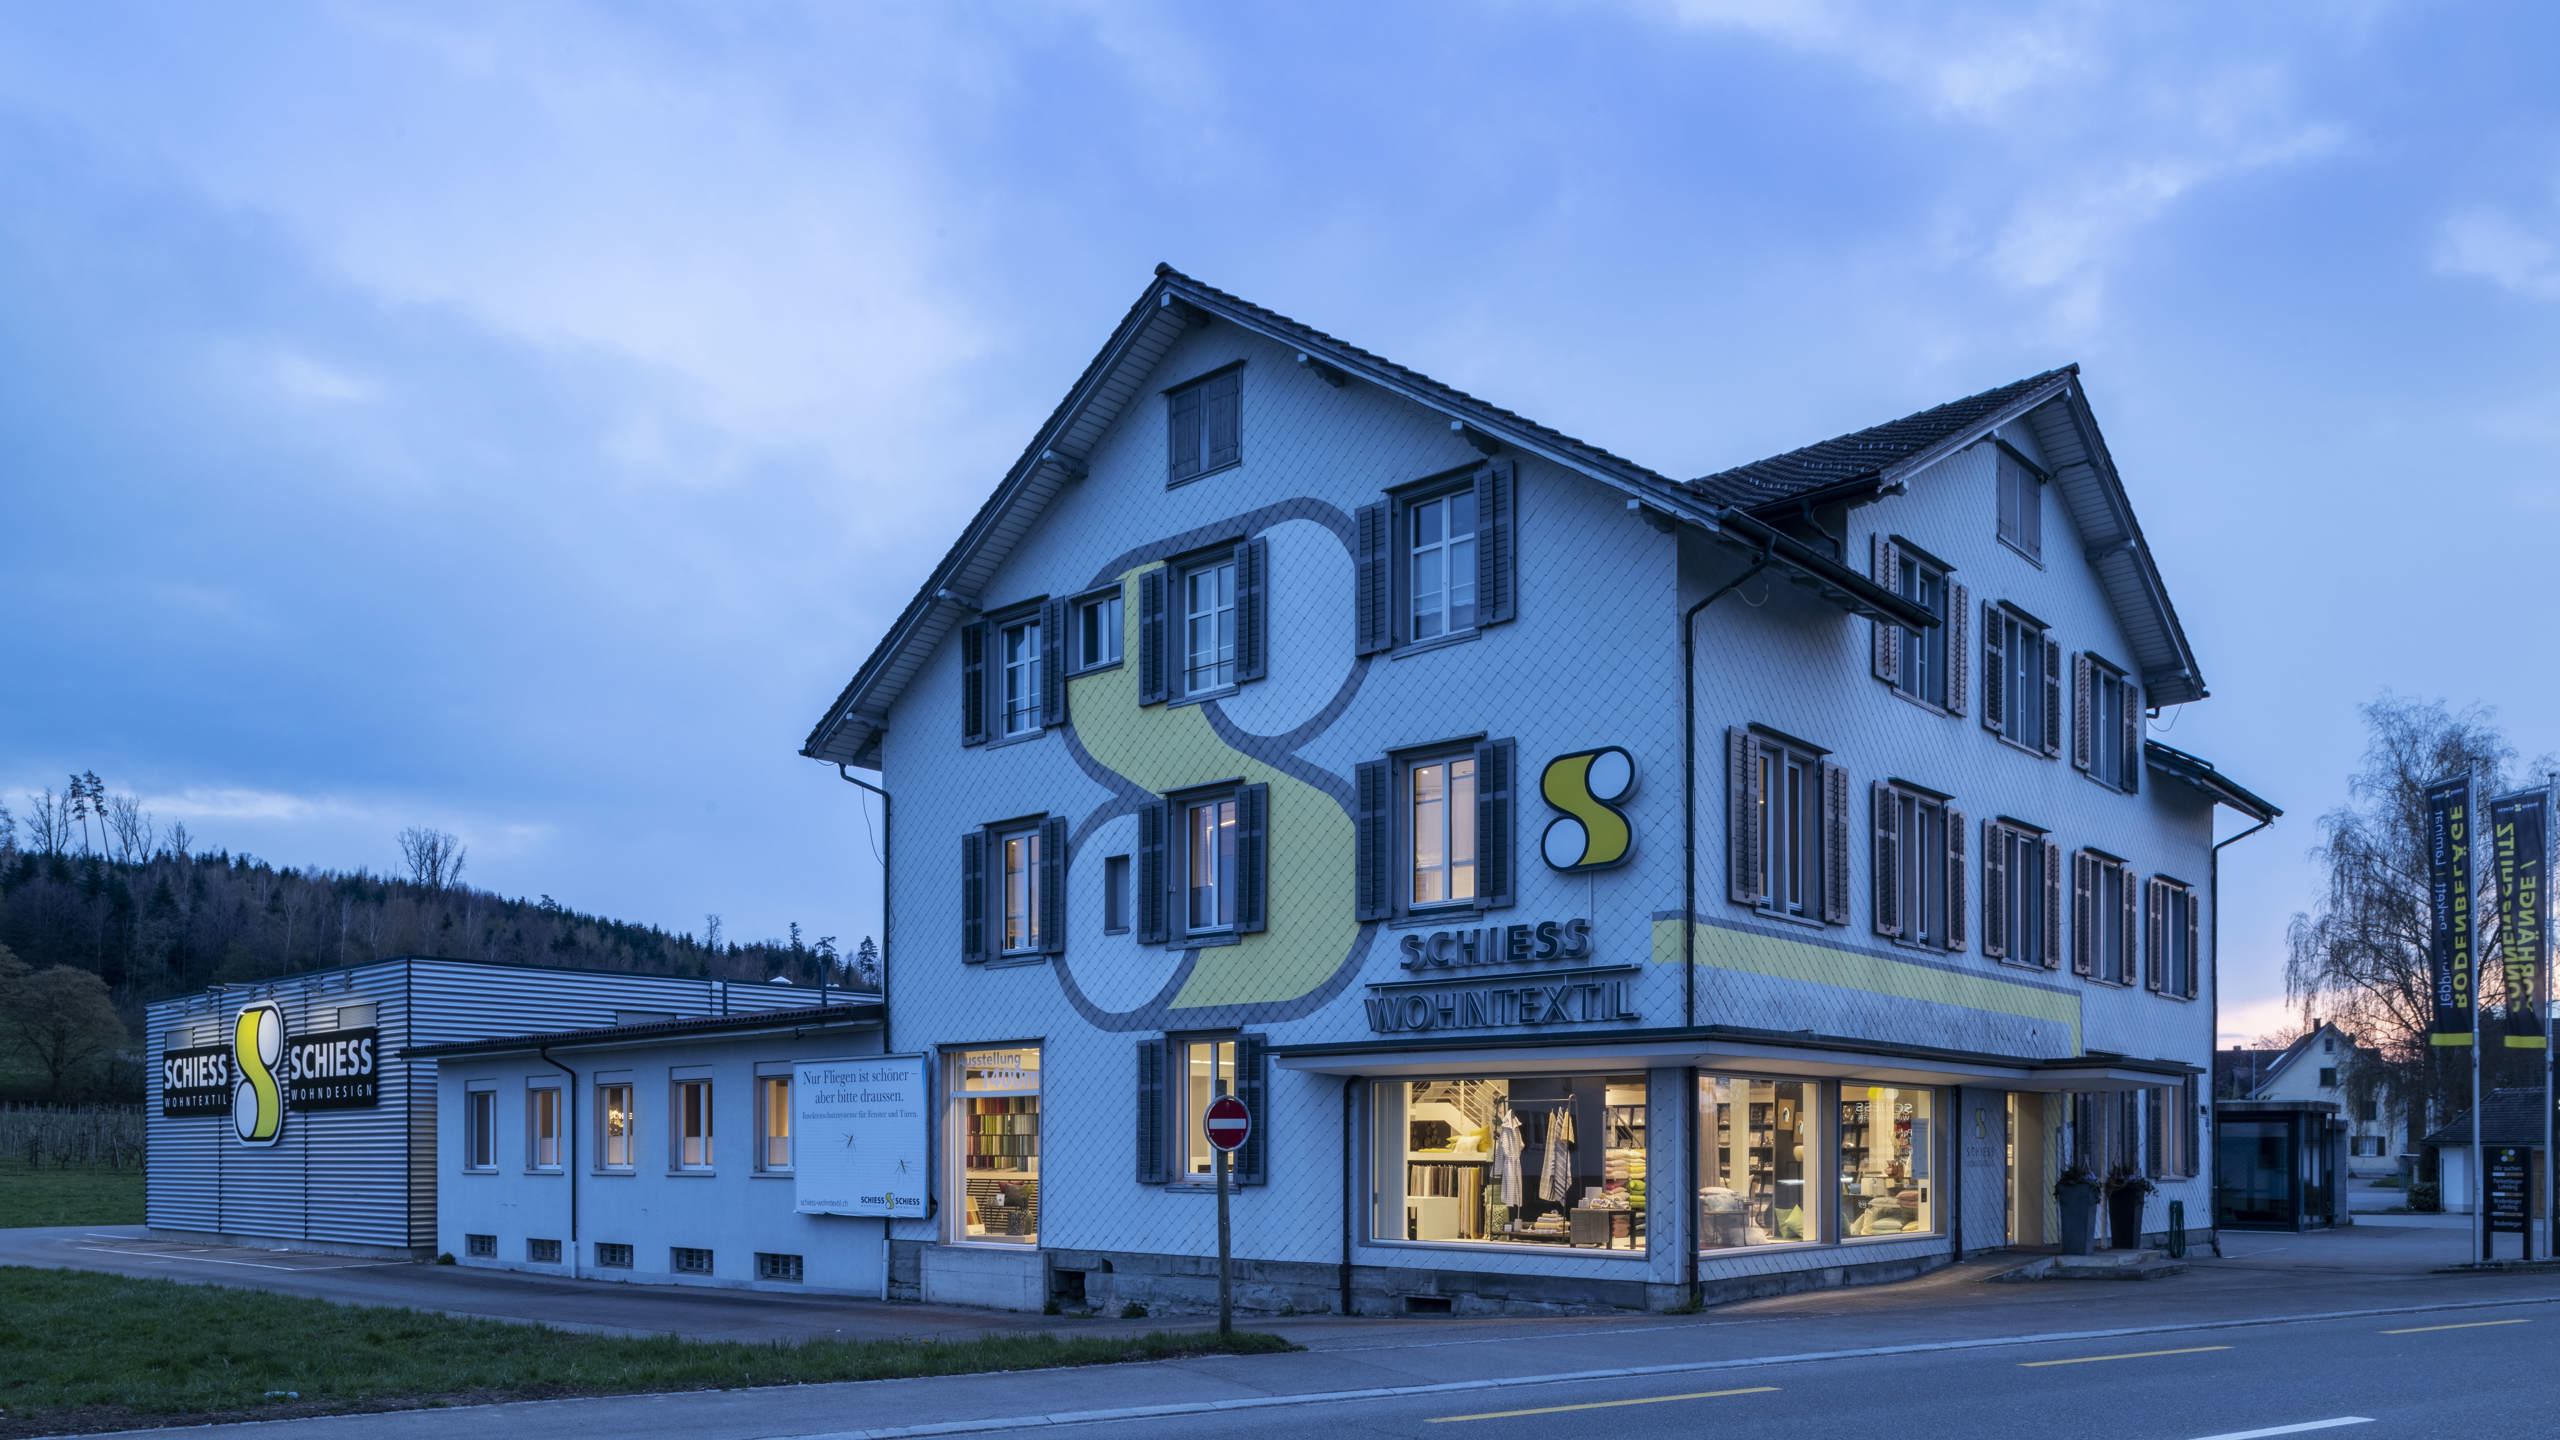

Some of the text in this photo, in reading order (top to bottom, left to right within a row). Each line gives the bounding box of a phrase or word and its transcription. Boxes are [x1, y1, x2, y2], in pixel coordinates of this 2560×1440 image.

[1400, 917, 1594, 970] SCHIESS
[1364, 980, 1642, 1032] WOHNTEXTIL
[290, 1038, 373, 1081] SCHIESS
[958, 1052, 1021, 1067] Ausstellung
[164, 1054, 228, 1090] SCHIESS
[803, 1071, 822, 1085] Nur
[823, 1069, 856, 1086] Fliegen
[858, 1069, 870, 1082] ist
[871, 1067, 909, 1082] schöner
[164, 1093, 228, 1108] WOHNTEXTIL
[291, 1084, 373, 1101] WOHNDESIGN
[815, 1088, 904, 1104] aber bitte draussen.
[860, 1196, 920, 1206] SCHIESS SCHIESS
